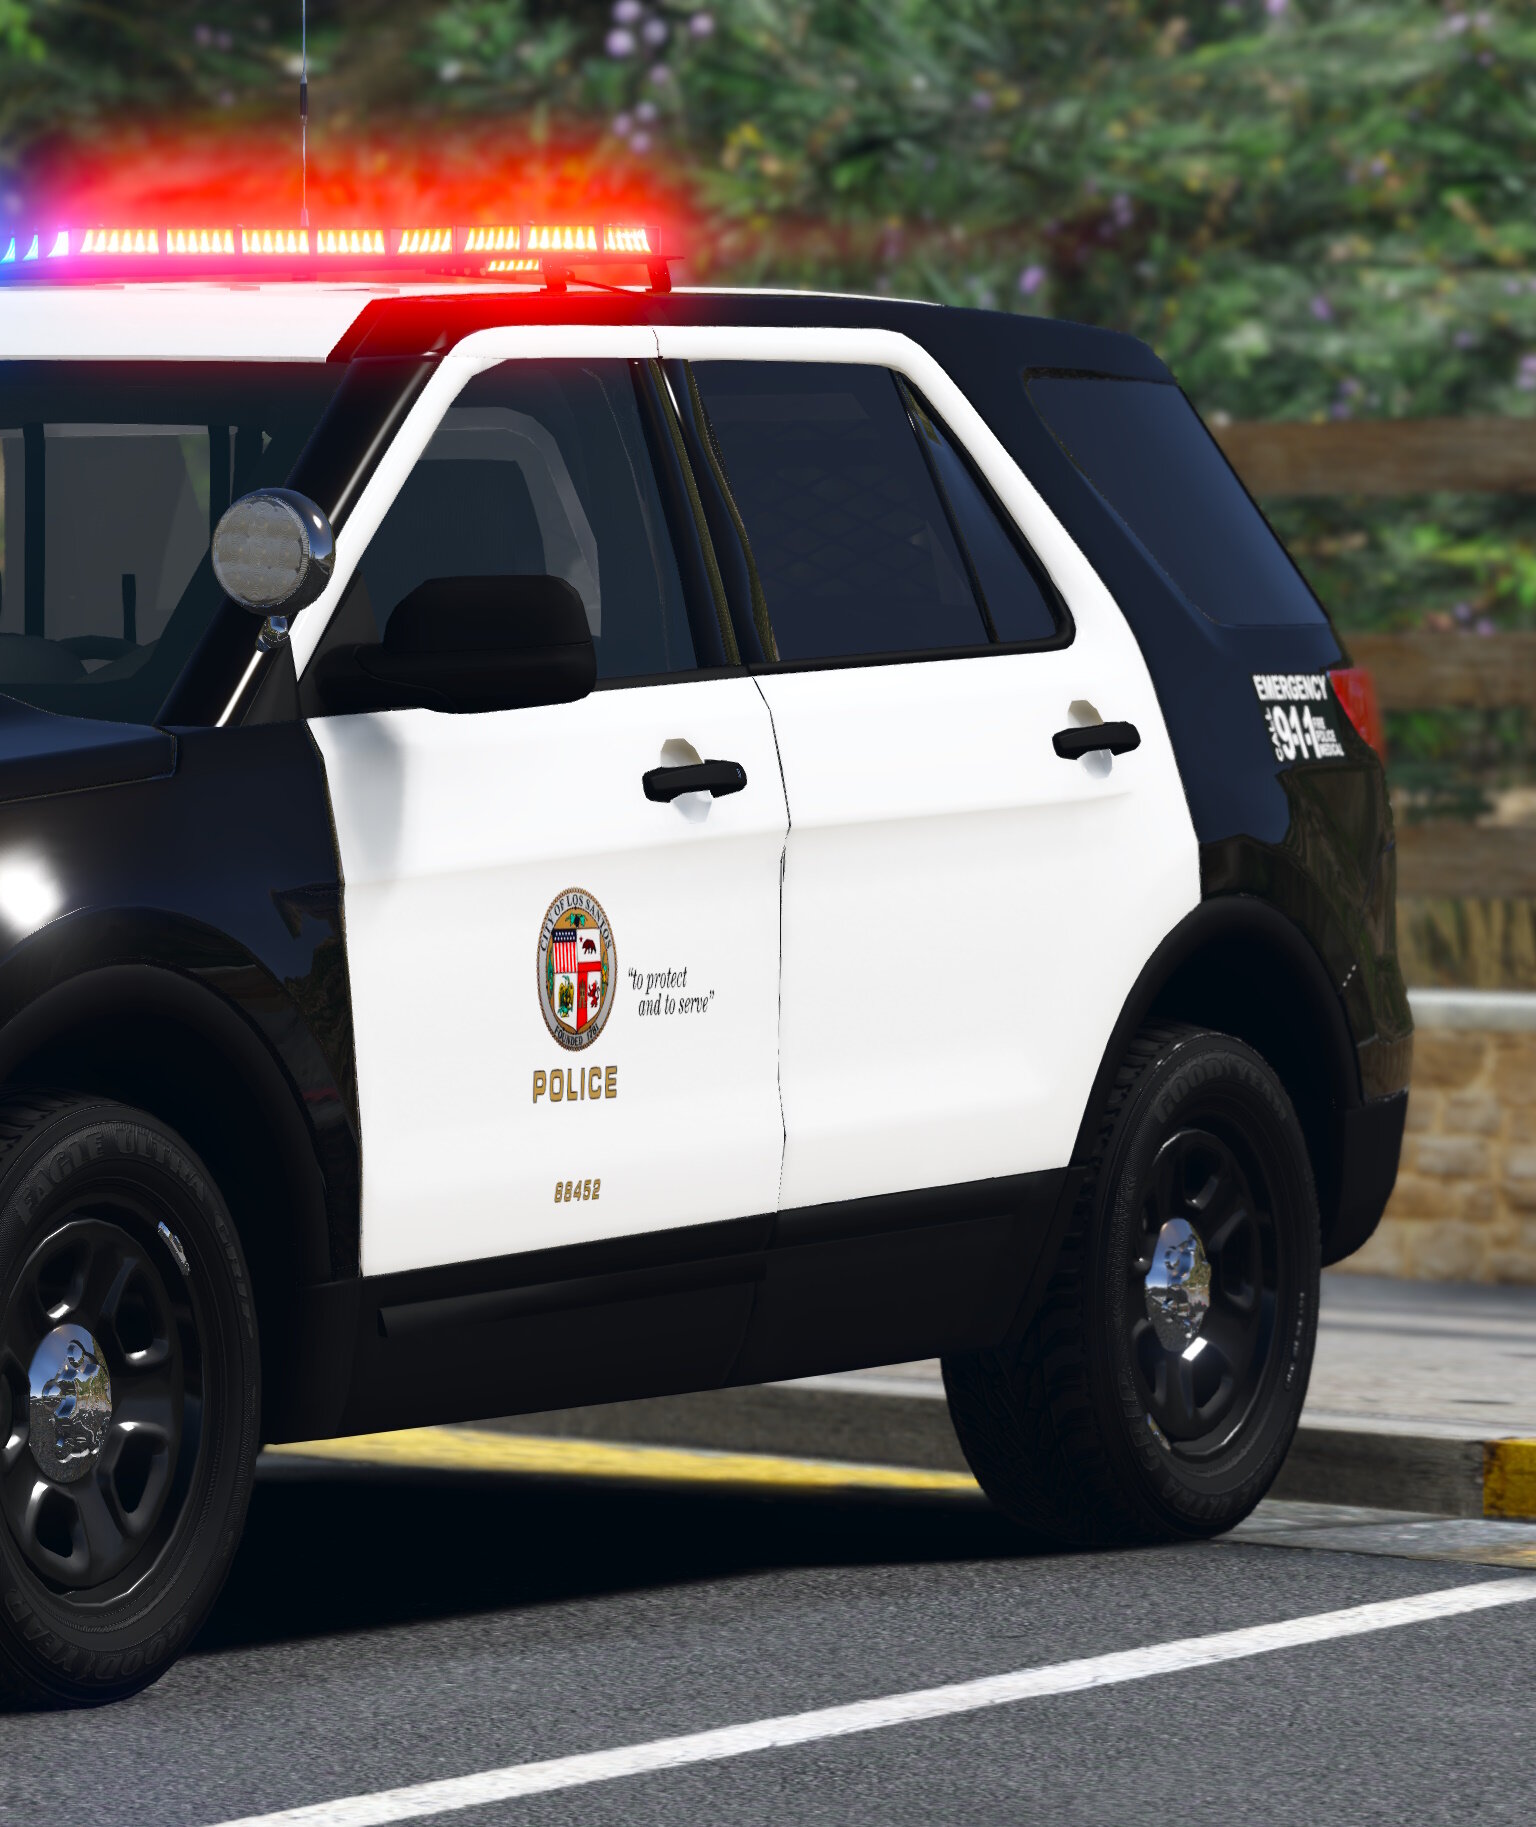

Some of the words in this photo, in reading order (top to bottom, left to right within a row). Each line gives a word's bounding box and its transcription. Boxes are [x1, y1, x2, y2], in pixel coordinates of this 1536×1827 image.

[1252, 675, 1328, 701] EMERGENCY
[541, 912, 554, 951] CITY
[554, 899, 565, 916] OF
[566, 894, 584, 907] LOS
[585, 898, 612, 949] SANTOS
[645, 966, 687, 995] protect
[638, 993, 662, 1016] and
[664, 994, 676, 1015] to
[555, 1025, 584, 1046] FOUNDED
[532, 1065, 617, 1103] POLICE
